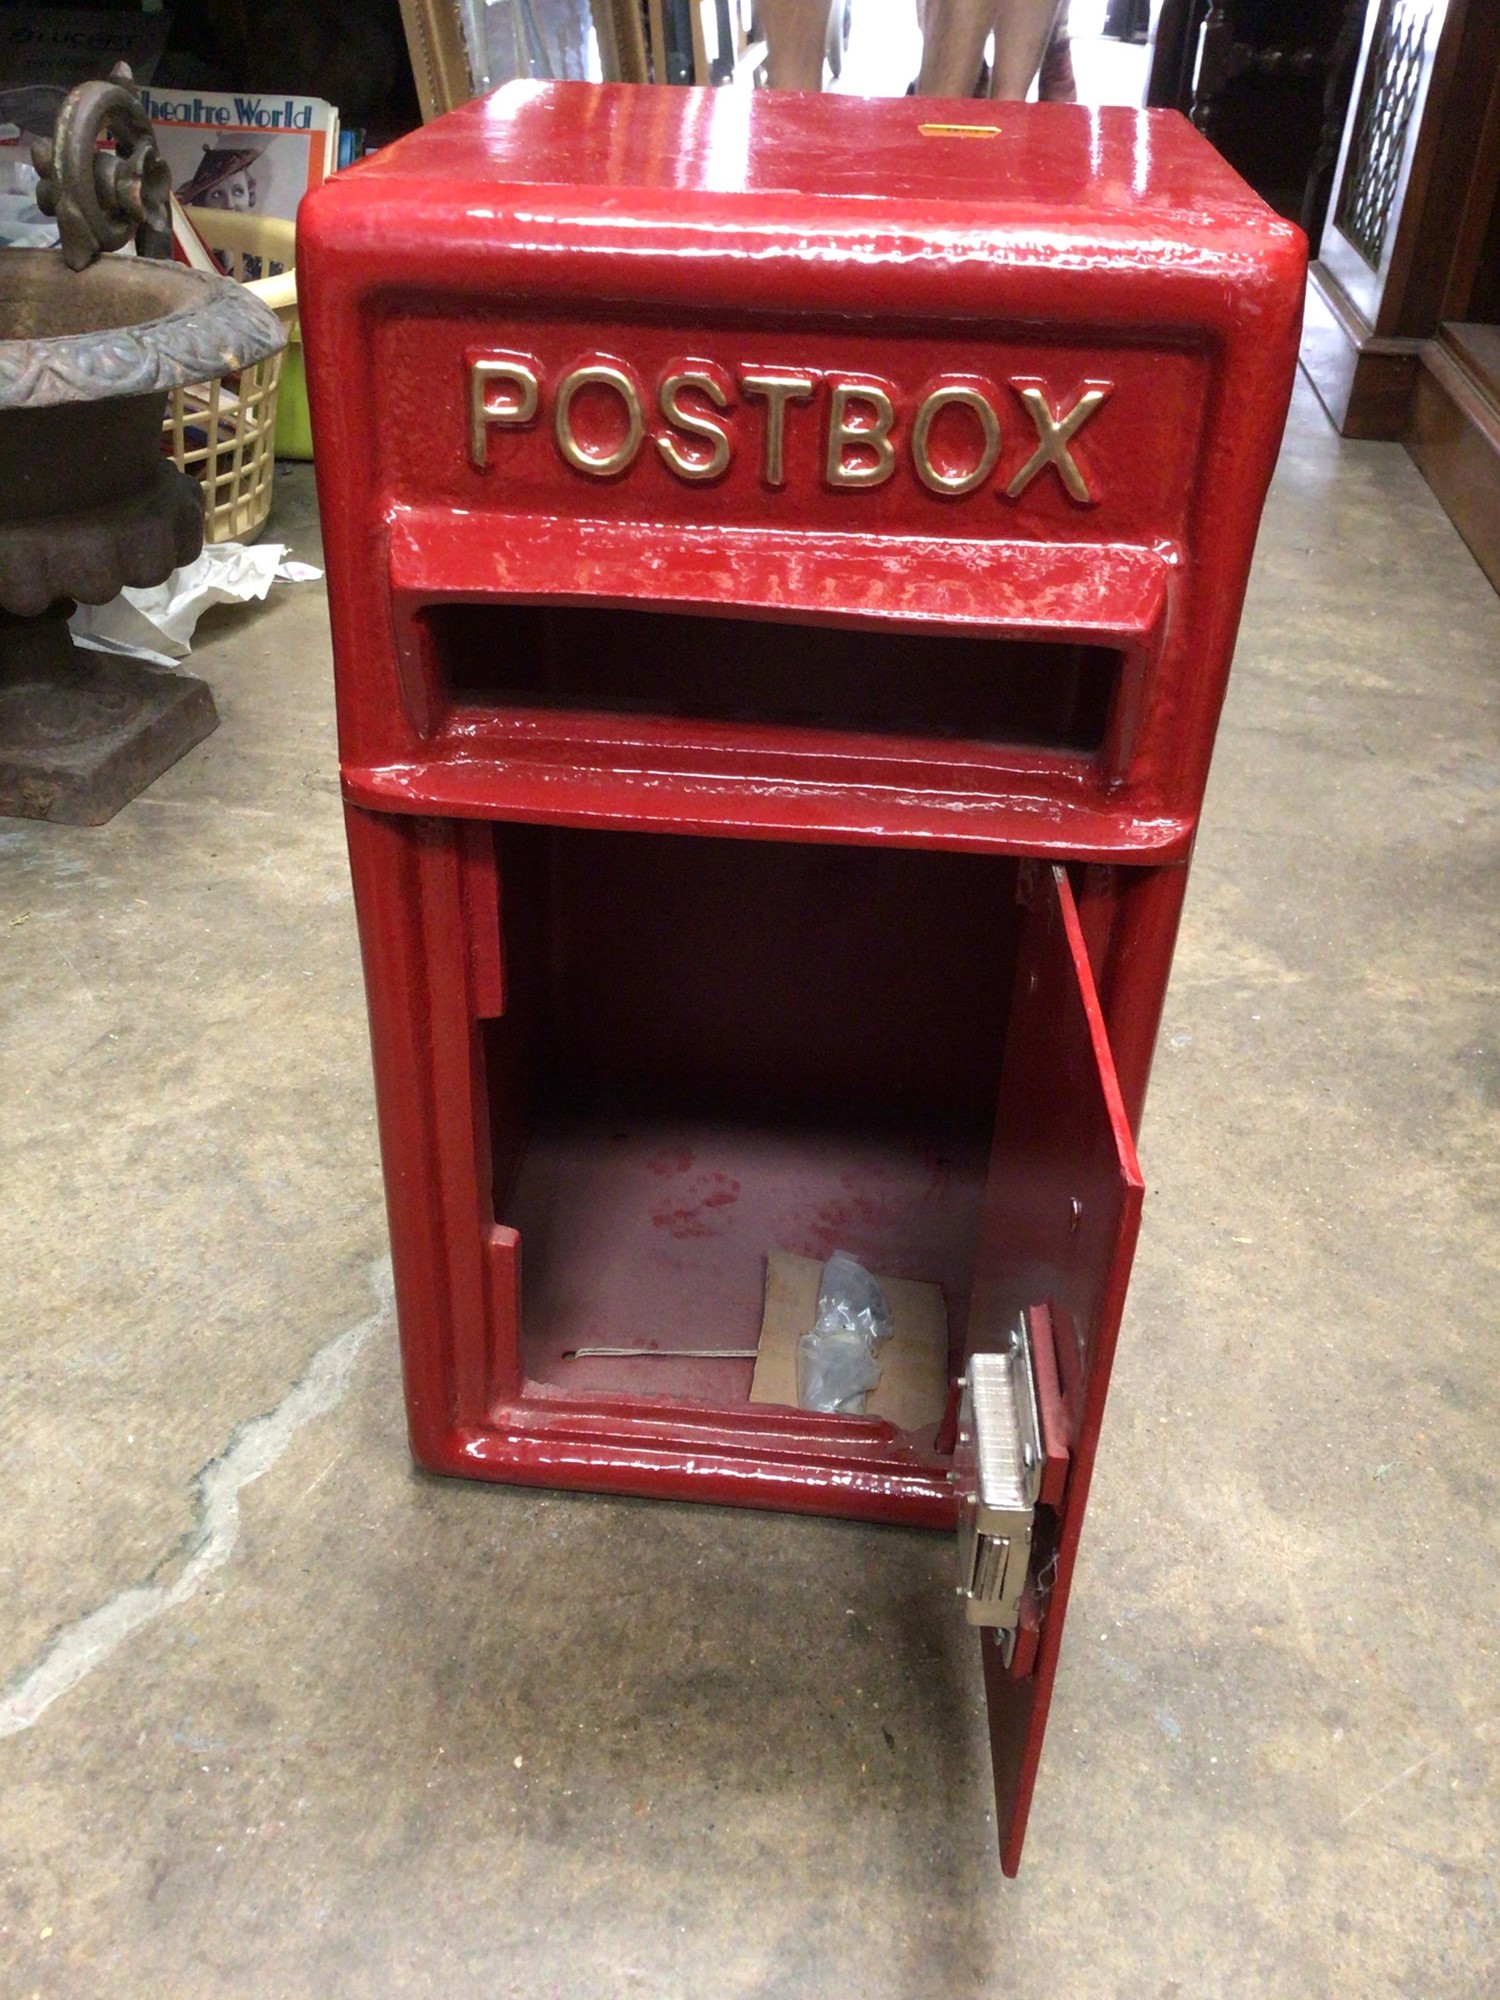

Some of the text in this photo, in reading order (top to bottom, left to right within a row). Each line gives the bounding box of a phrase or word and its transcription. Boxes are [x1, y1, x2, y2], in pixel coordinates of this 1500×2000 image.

[140, 90, 313, 129] heatre World
[467, 354, 1109, 503] POSTBOX
